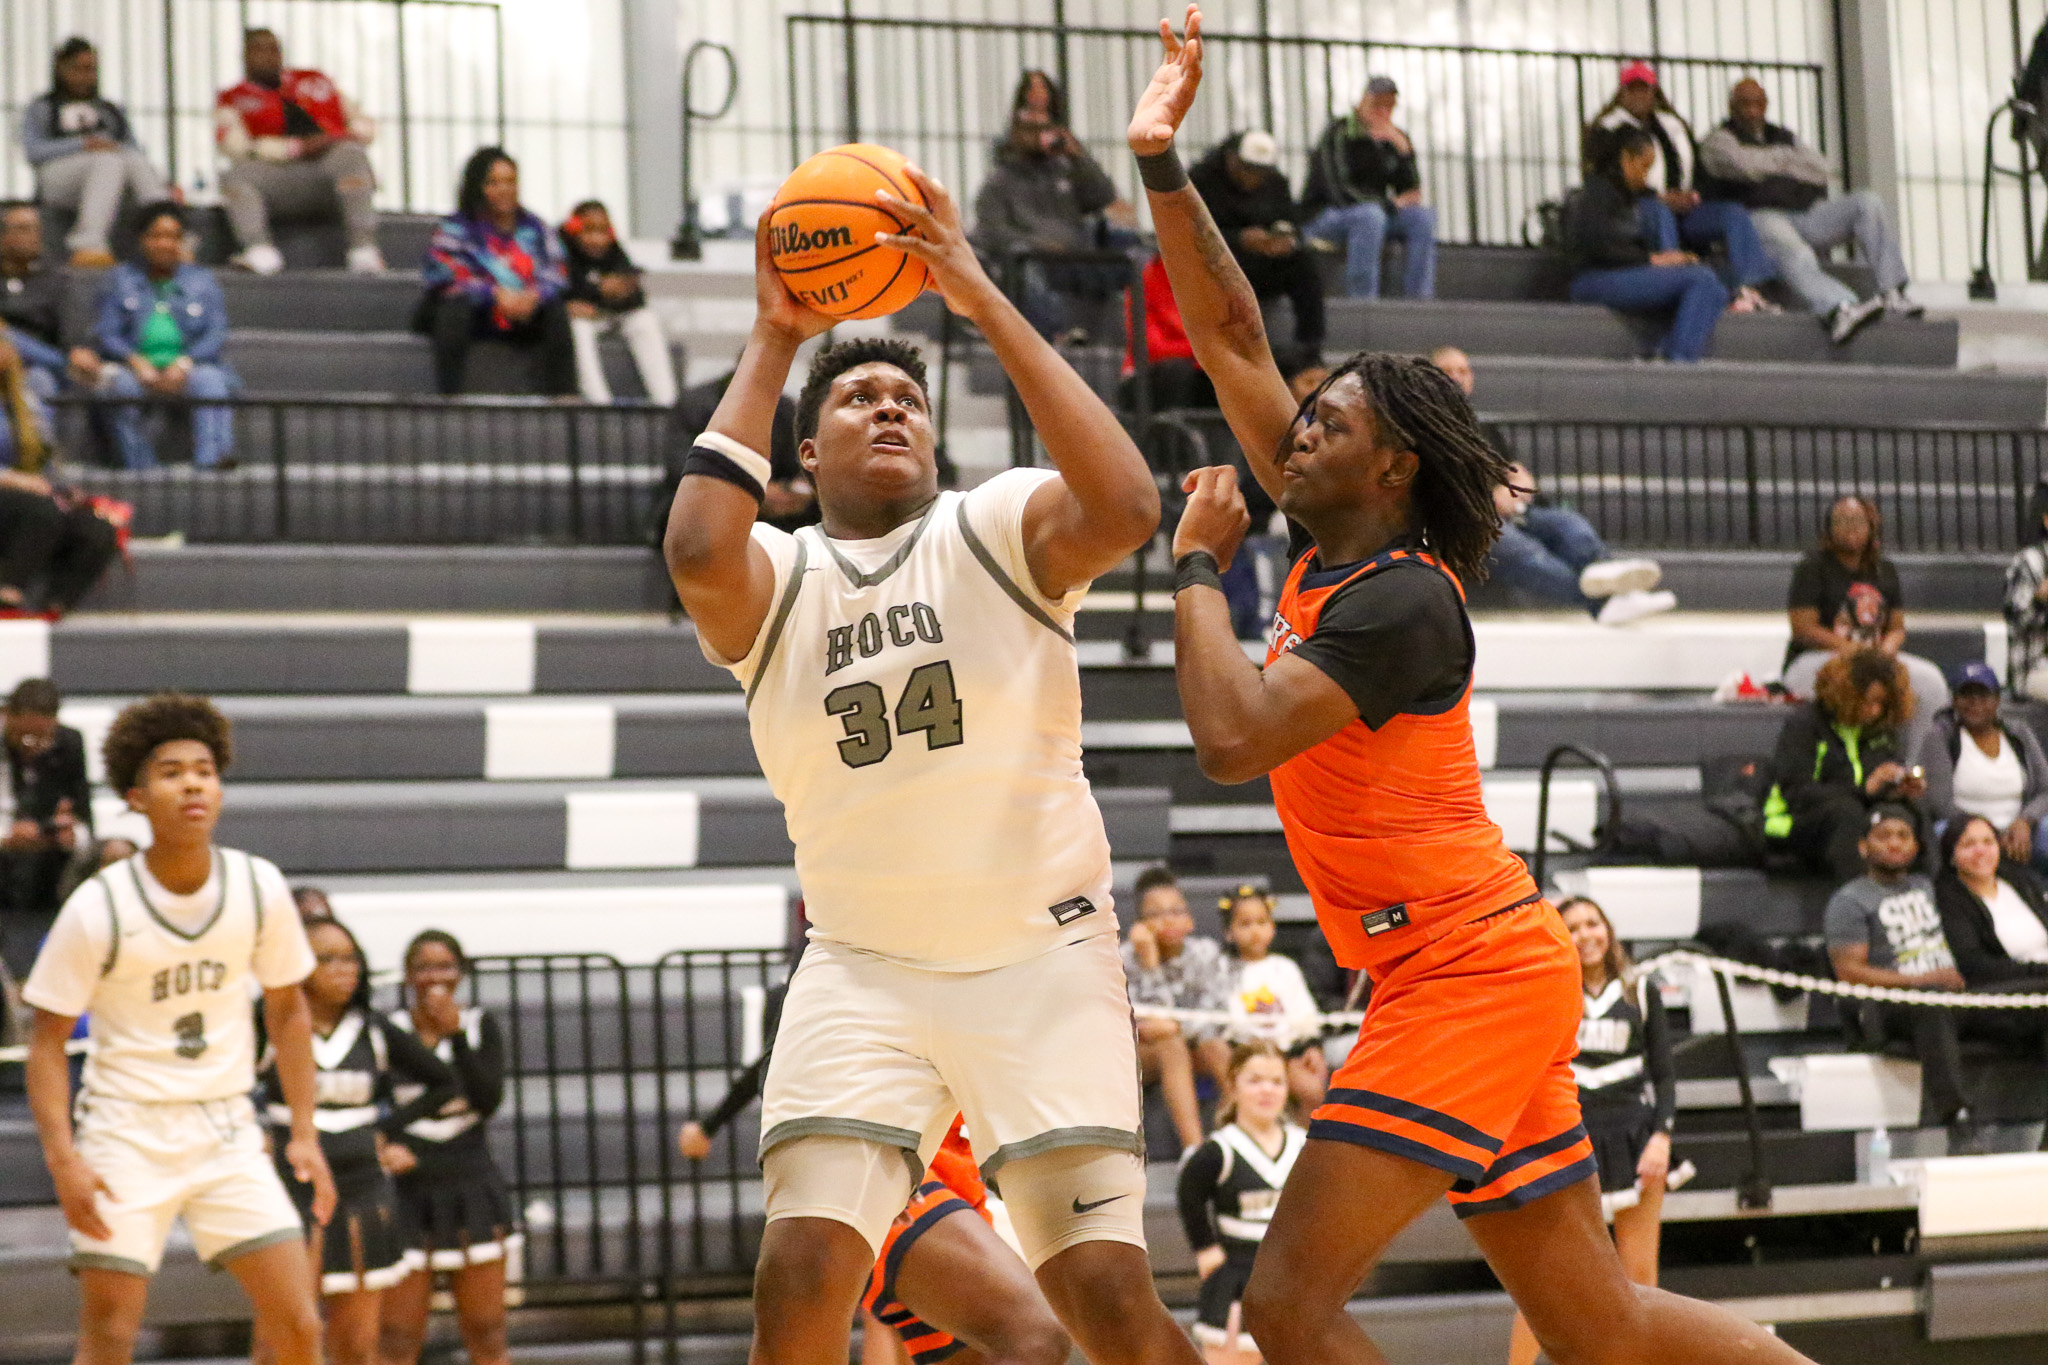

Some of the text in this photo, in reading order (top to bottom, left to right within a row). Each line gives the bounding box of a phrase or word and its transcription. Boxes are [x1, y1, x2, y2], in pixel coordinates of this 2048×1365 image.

[770, 222, 852, 257] Wilson
[825, 602, 944, 677] HOCO
[824, 659, 964, 769] 34
